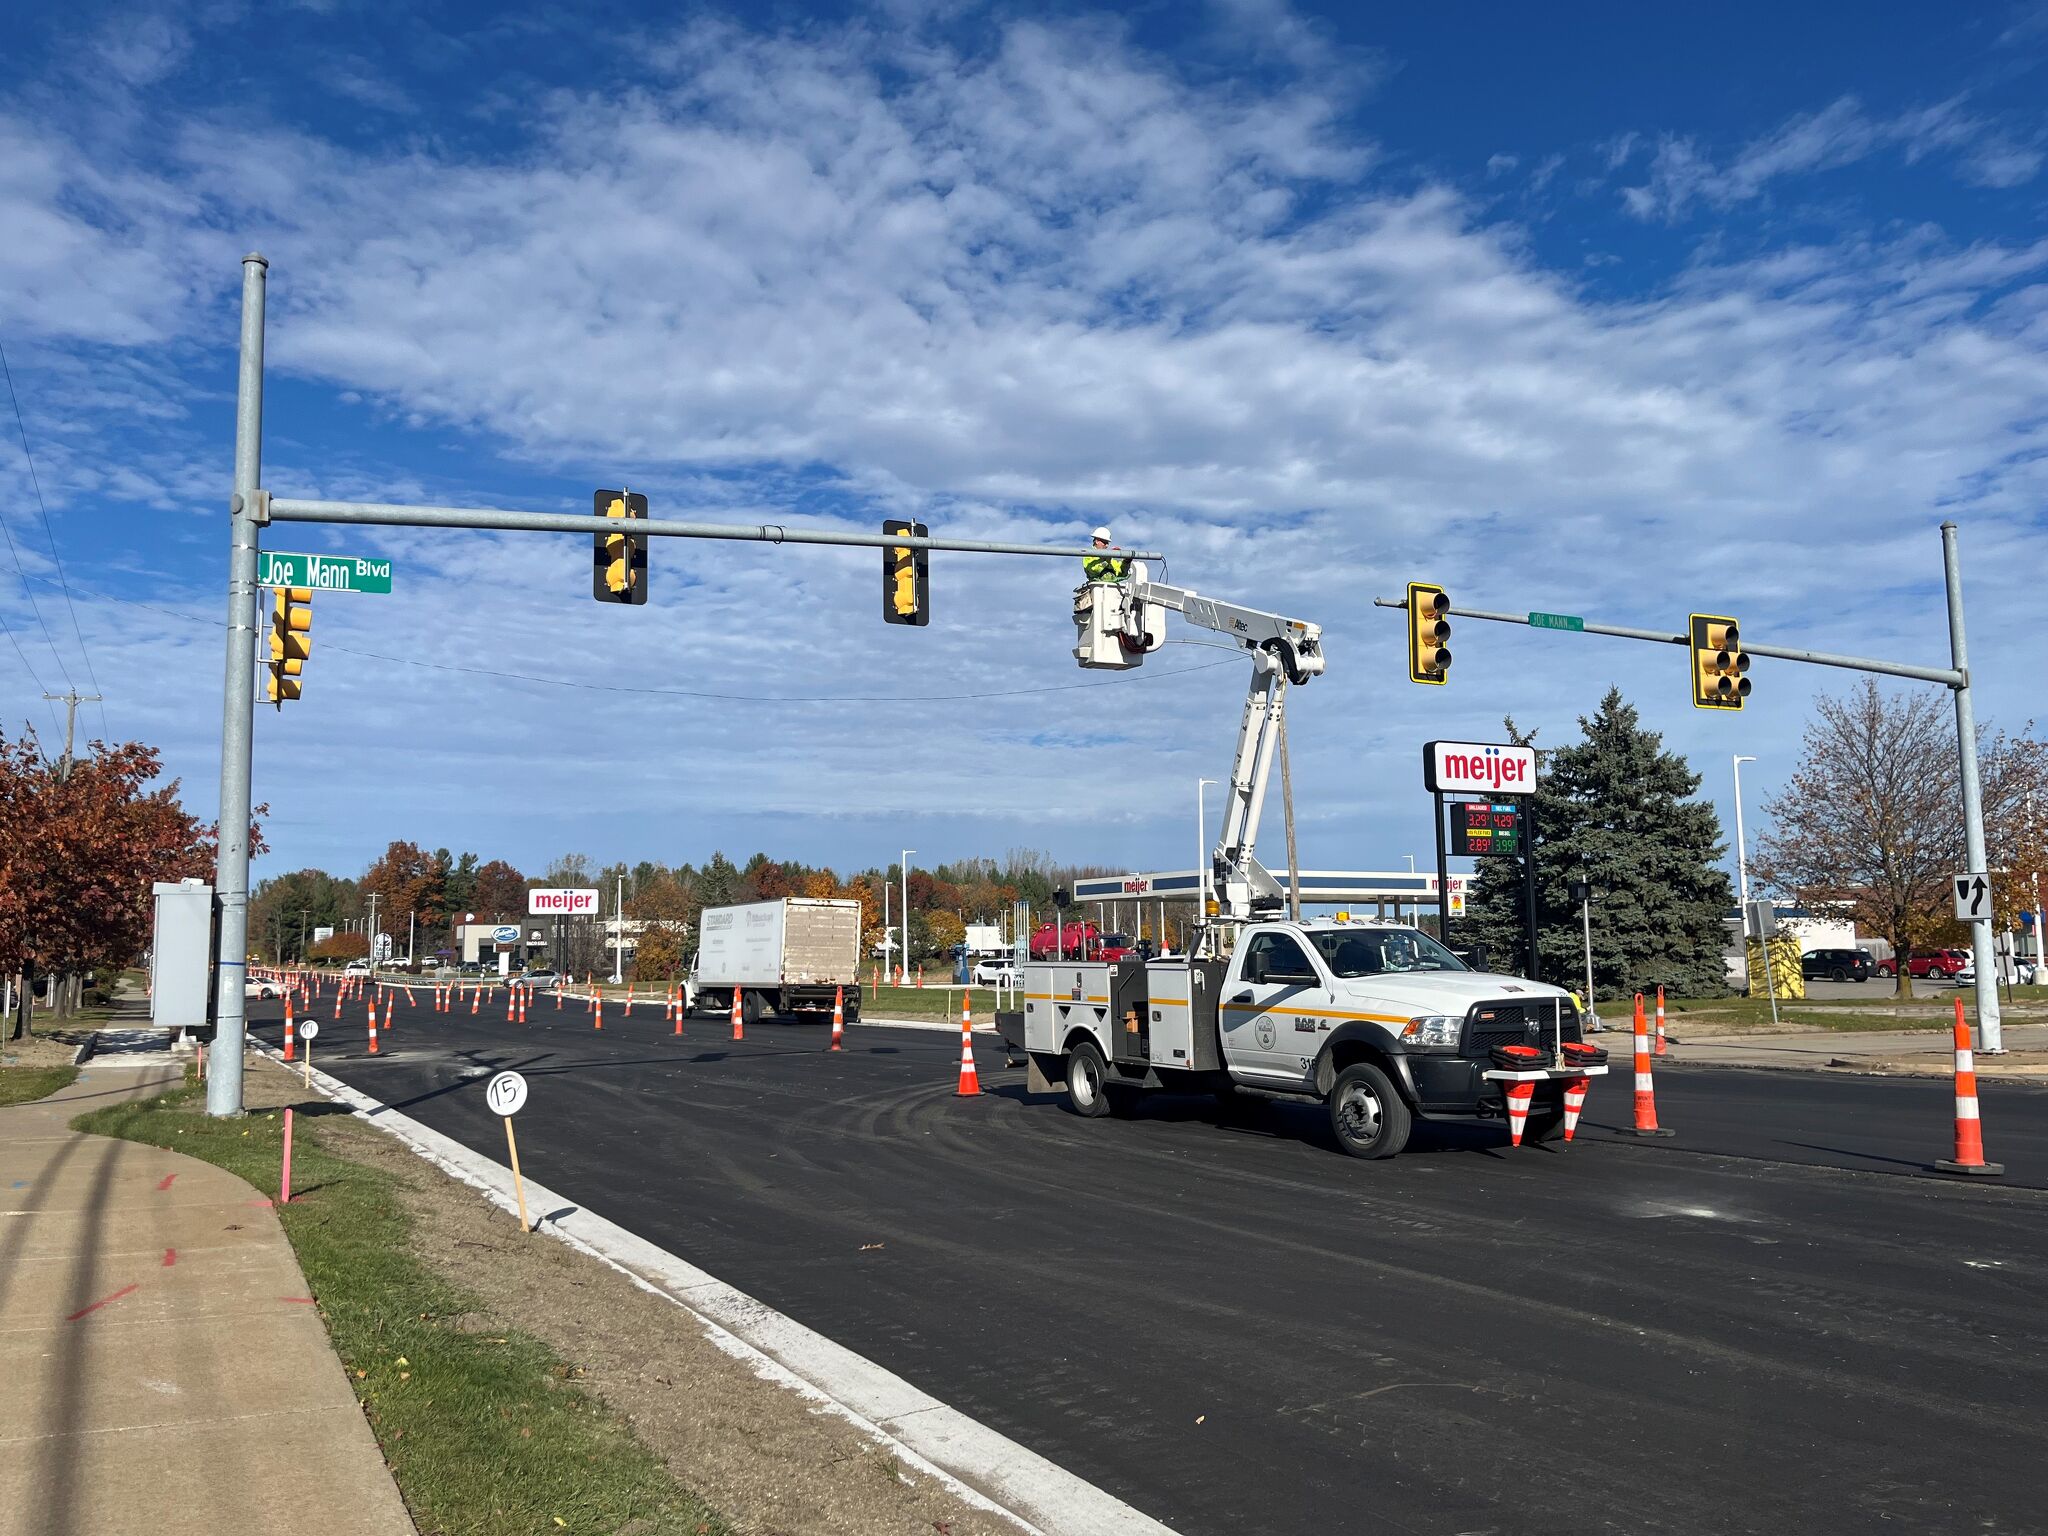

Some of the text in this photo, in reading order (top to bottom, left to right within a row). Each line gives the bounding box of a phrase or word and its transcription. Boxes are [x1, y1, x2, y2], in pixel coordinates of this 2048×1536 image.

[262, 553, 390, 589] Joe Mann Blvd
[1234, 618, 1248, 632] Altec
[1532, 613, 1546, 626] JOE
[1548, 615, 1568, 629] MANN
[1445, 747, 1527, 789] meijer
[1124, 877, 1148, 896] meijer
[1432, 876, 1462, 892] mijer
[535, 890, 593, 913] meijer
[1294, 1017, 1316, 1025] RAM
[494, 1078, 517, 1107] 15
